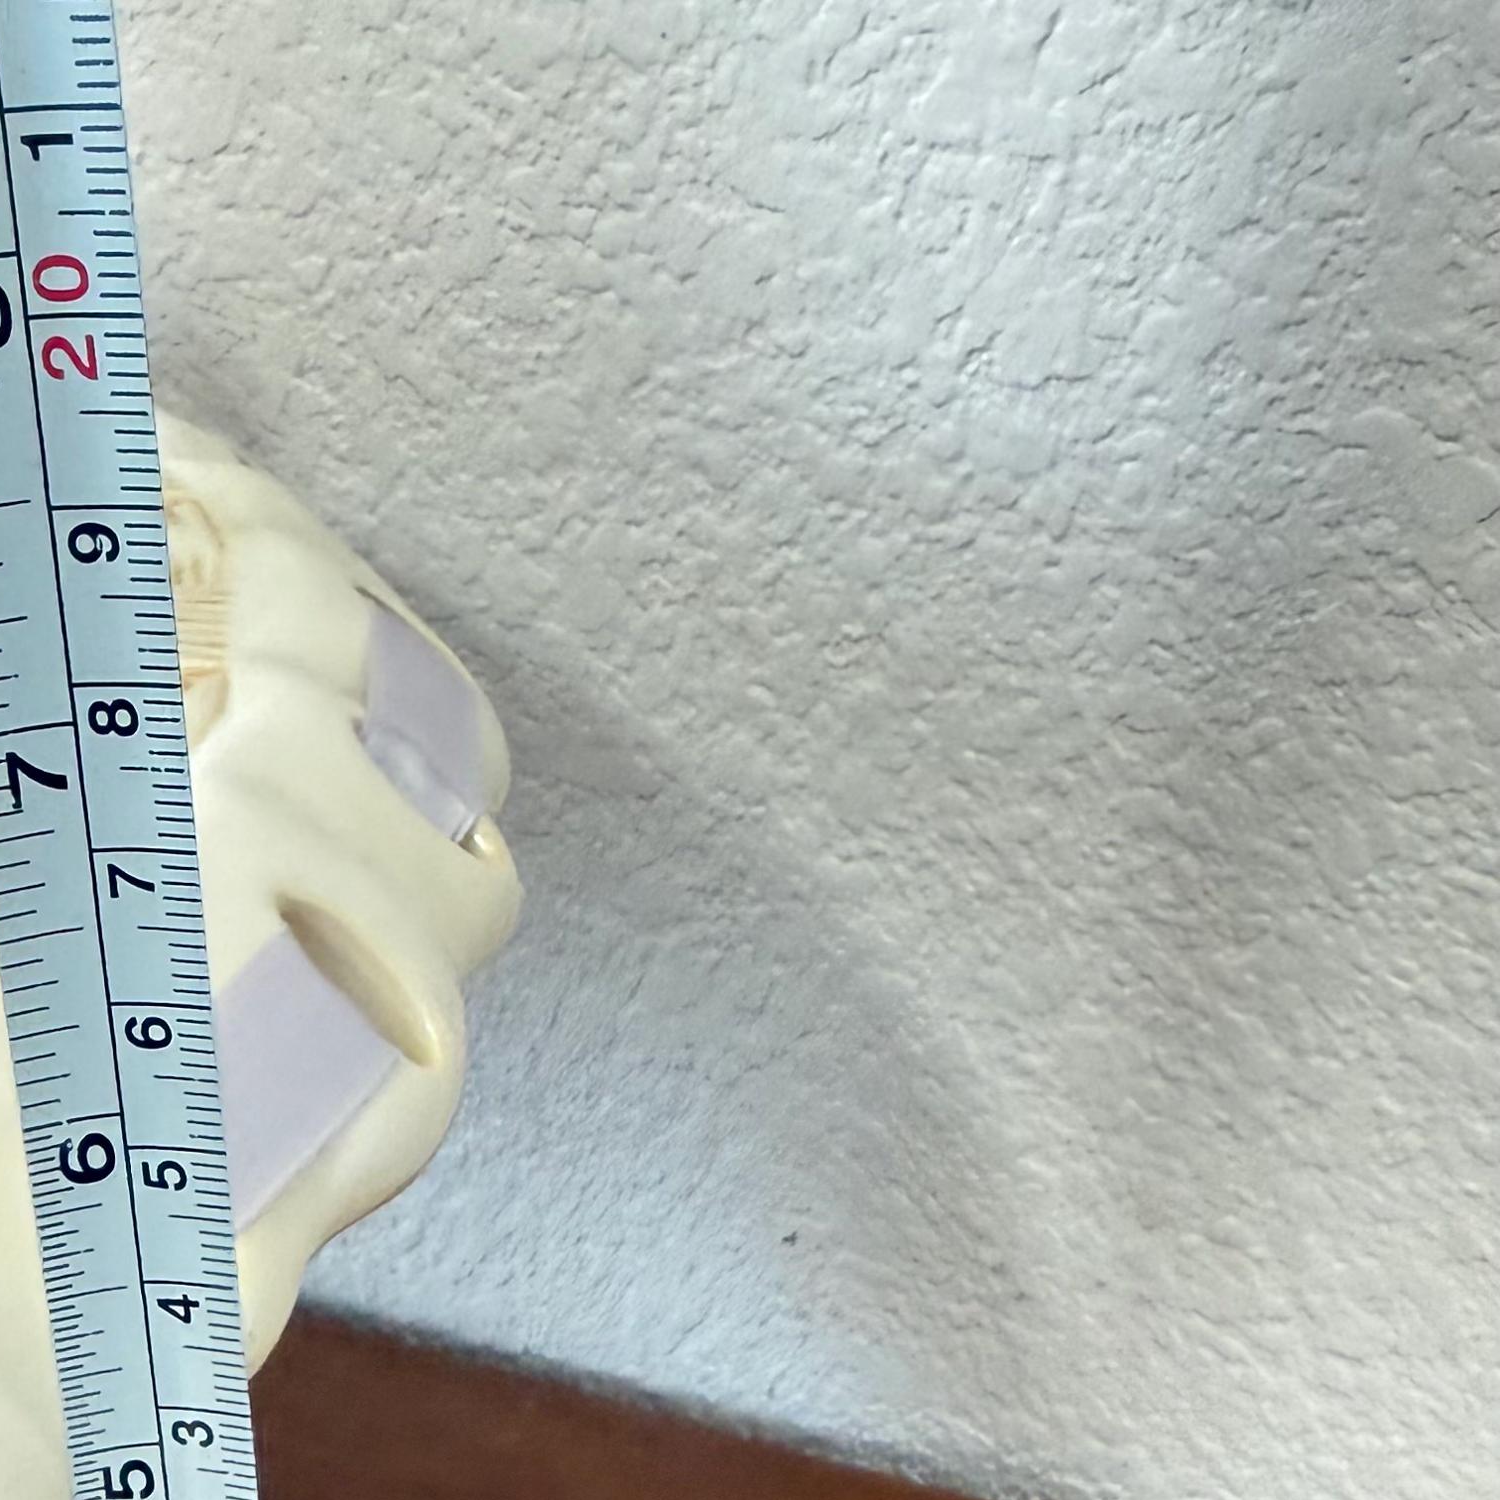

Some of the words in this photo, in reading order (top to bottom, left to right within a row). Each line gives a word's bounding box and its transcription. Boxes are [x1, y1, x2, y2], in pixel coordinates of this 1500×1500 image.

[20, 134, 74, 161] 1
[32, 254, 99, 381] 20
[68, 522, 120, 563] 9
[88, 698, 139, 737] 8
[5, 752, 68, 808] 7
[107, 863, 155, 898] 7
[124, 1016, 173, 1050] 6
[59, 1132, 116, 1184] 6
[141, 1160, 187, 1191] 5
[156, 1294, 200, 1324] 4
[172, 1420, 214, 1447] 3
[103, 1459, 155, 1500] 5
